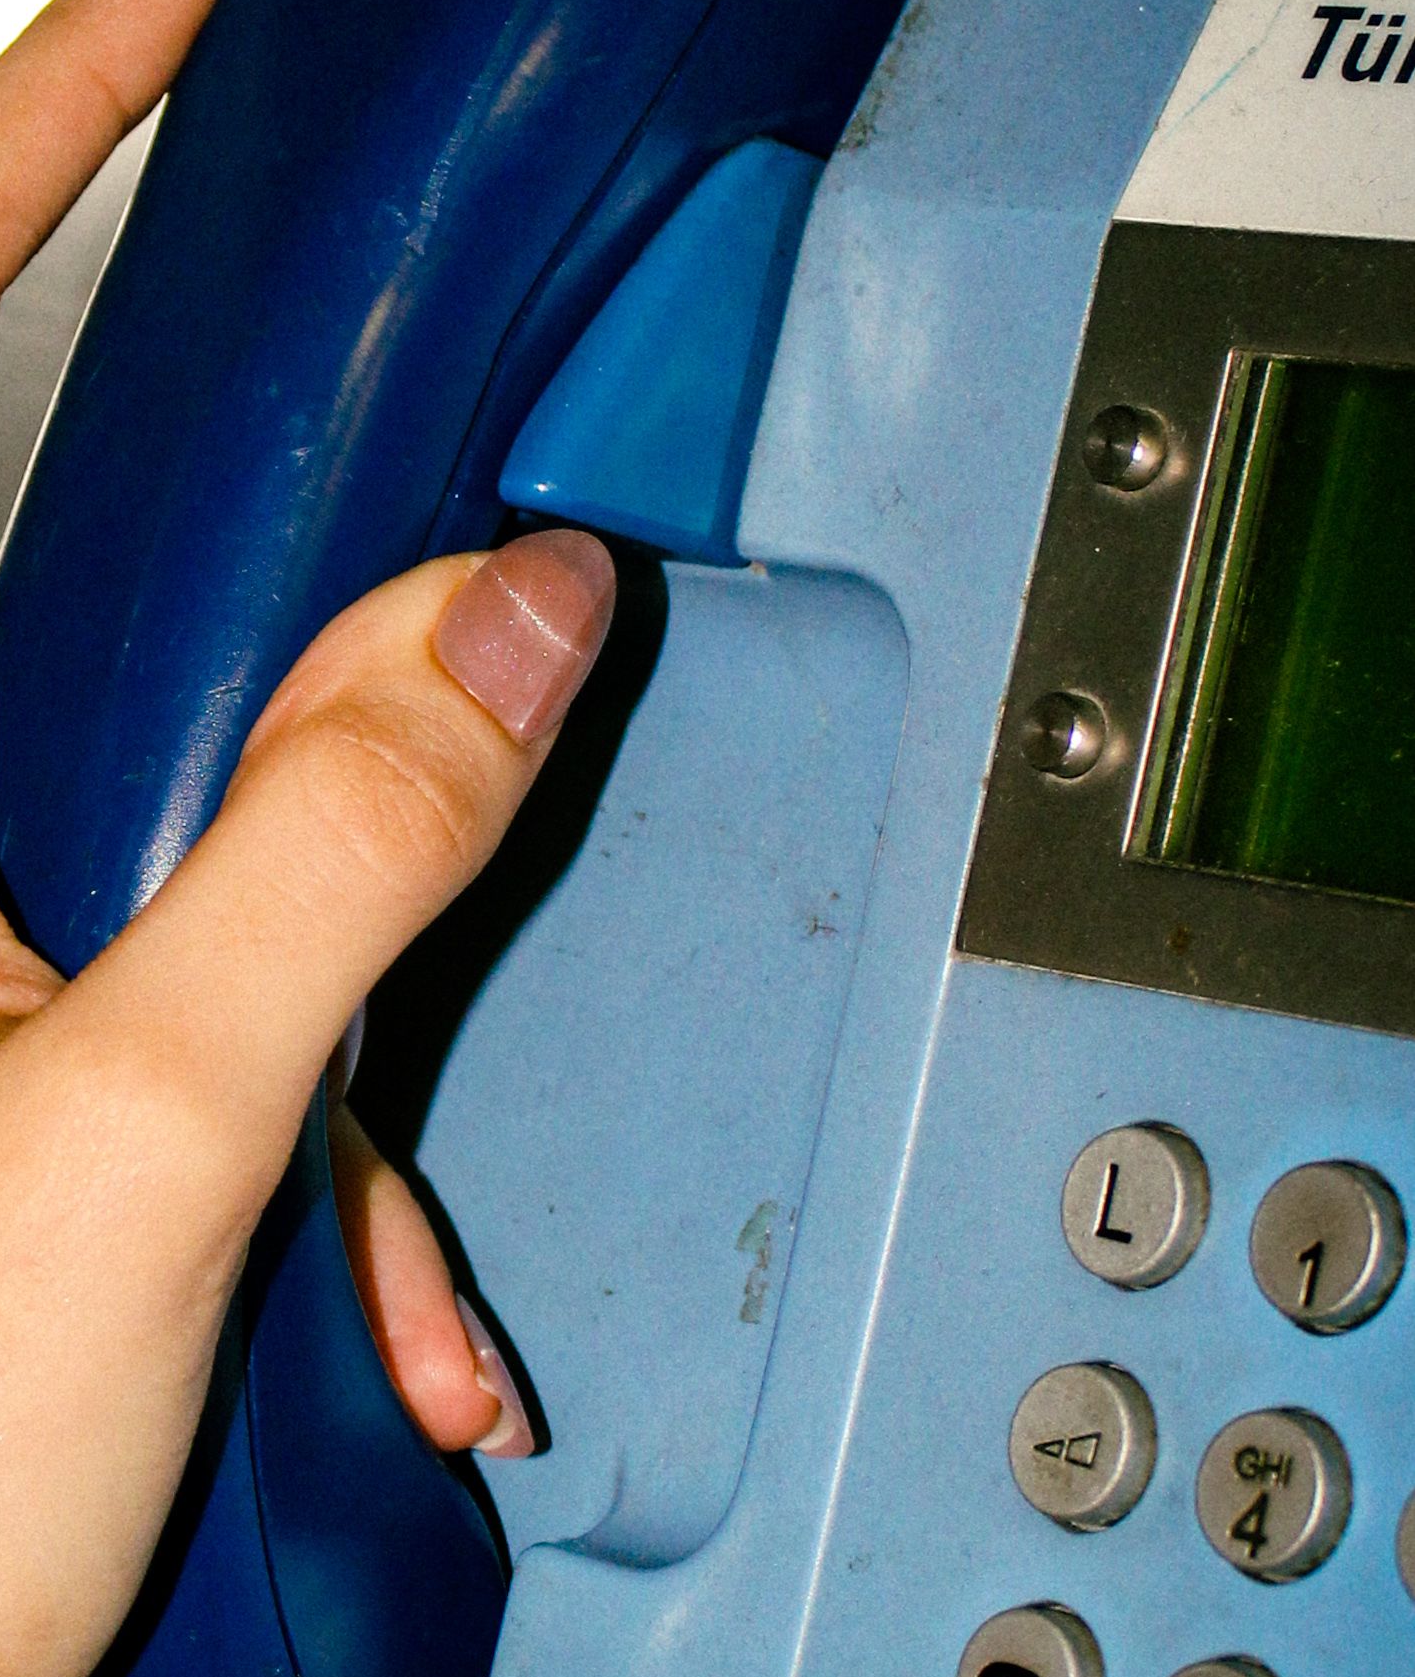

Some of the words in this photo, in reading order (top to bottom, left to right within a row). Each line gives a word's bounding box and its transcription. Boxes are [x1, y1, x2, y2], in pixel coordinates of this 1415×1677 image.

[1094, 1162, 1133, 1244] L
[1298, 1240, 1325, 1308] 1
[1233, 1446, 1292, 1487] GHI
[1230, 1491, 1267, 1557] 4
